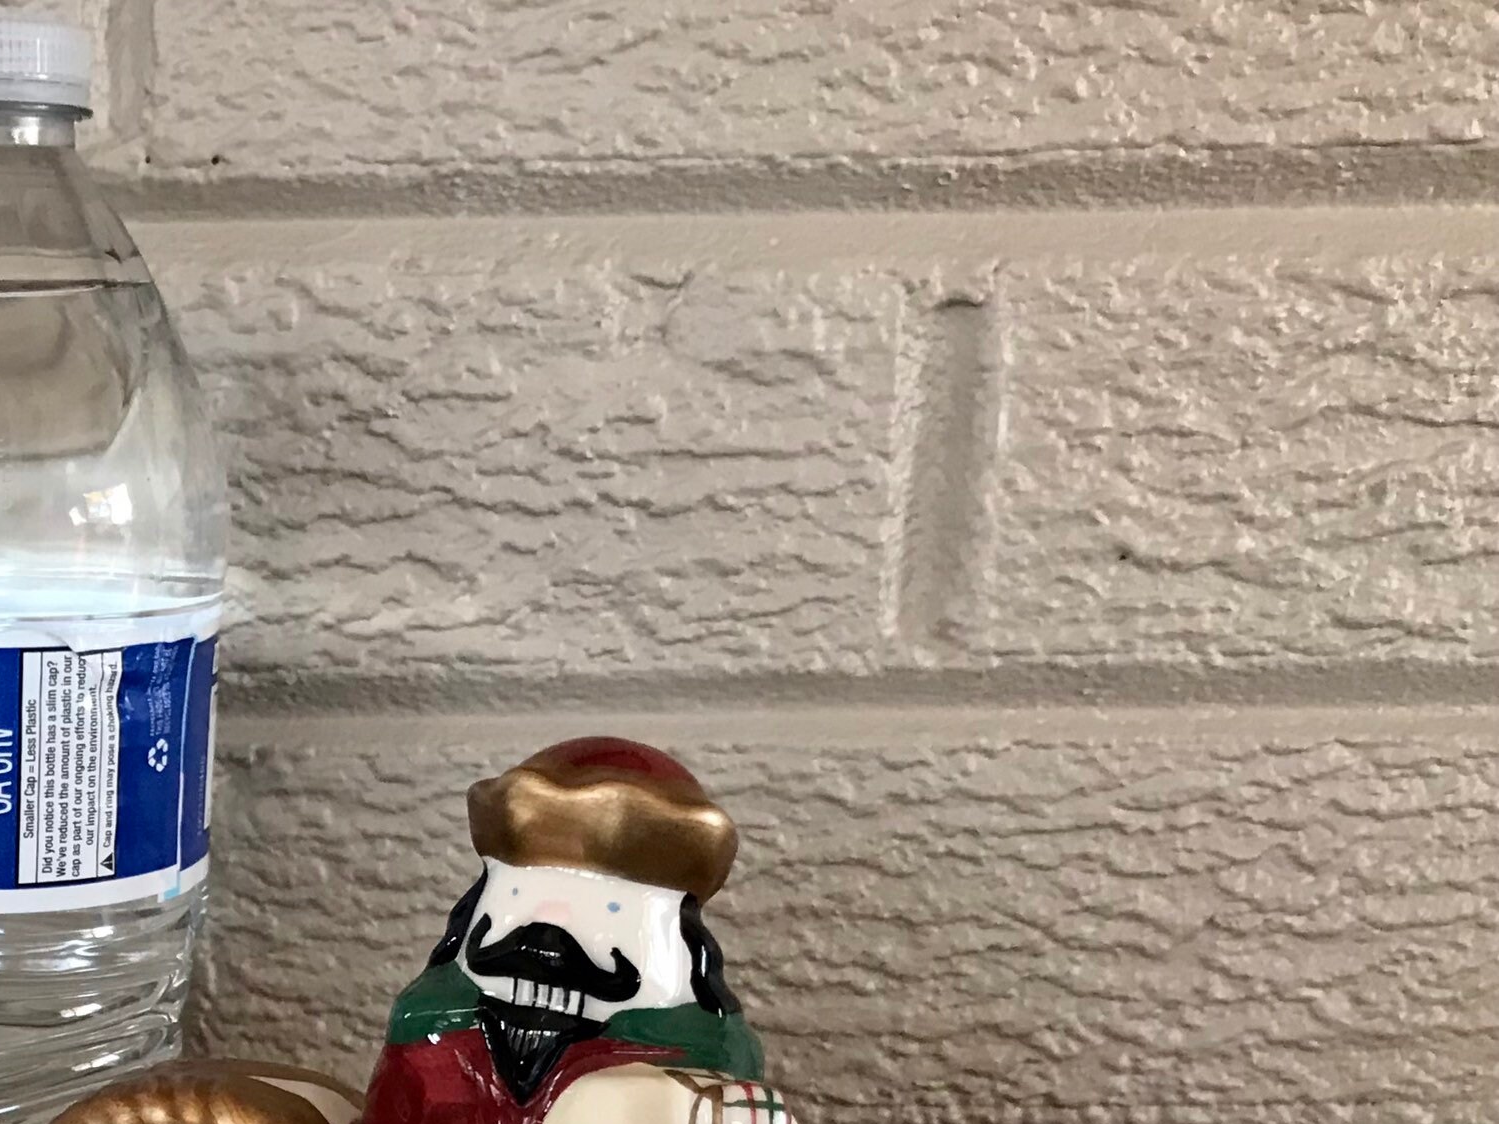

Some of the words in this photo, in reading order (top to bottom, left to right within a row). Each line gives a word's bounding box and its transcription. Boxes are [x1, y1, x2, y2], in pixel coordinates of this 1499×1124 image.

[47, 660, 59, 686] cap?
[64, 654, 73, 674] our
[63, 676, 72, 686] in
[46, 689, 57, 712] slim
[61, 689, 73, 724] plastic
[76, 692, 85, 703] to
[25, 699, 37, 735] Plastic
[49, 714, 57, 722] a
[74, 705, 85, 740] efforts
[104, 694, 116, 733] choking
[46, 724, 57, 744] has
[60, 727, 71, 738] of
[25, 738, 36, 762] Less
[60, 740, 71, 780] amount
[107, 743, 115, 766] pose
[45, 746, 56, 776] bottle
[74, 742, 86, 785] ongoing
[87, 755, 97, 772] the
[24, 776, 37, 796] Cap
[87, 774, 96, 788] on
[106, 768, 115, 788] may
[44, 779, 55, 798] this
[59, 782, 69, 799] the
[74, 788, 83, 805] our
[85, 790, 97, 826] impact
[105, 790, 115, 808] ring
[23, 799, 35, 839] Smaller
[43, 801, 54, 833] notice
[57, 802, 69, 844] reduced
[72, 808, 82, 818] of
[104, 810, 113, 828] and
[73, 820, 83, 841] part
[85, 828, 94, 846] our
[103, 830, 113, 848] Cap
[45, 836, 55, 854] you
[73, 844, 81, 856] as
[41, 856, 53, 874] Did
[56, 846, 67, 877] We've
[71, 858, 82, 878] cap
